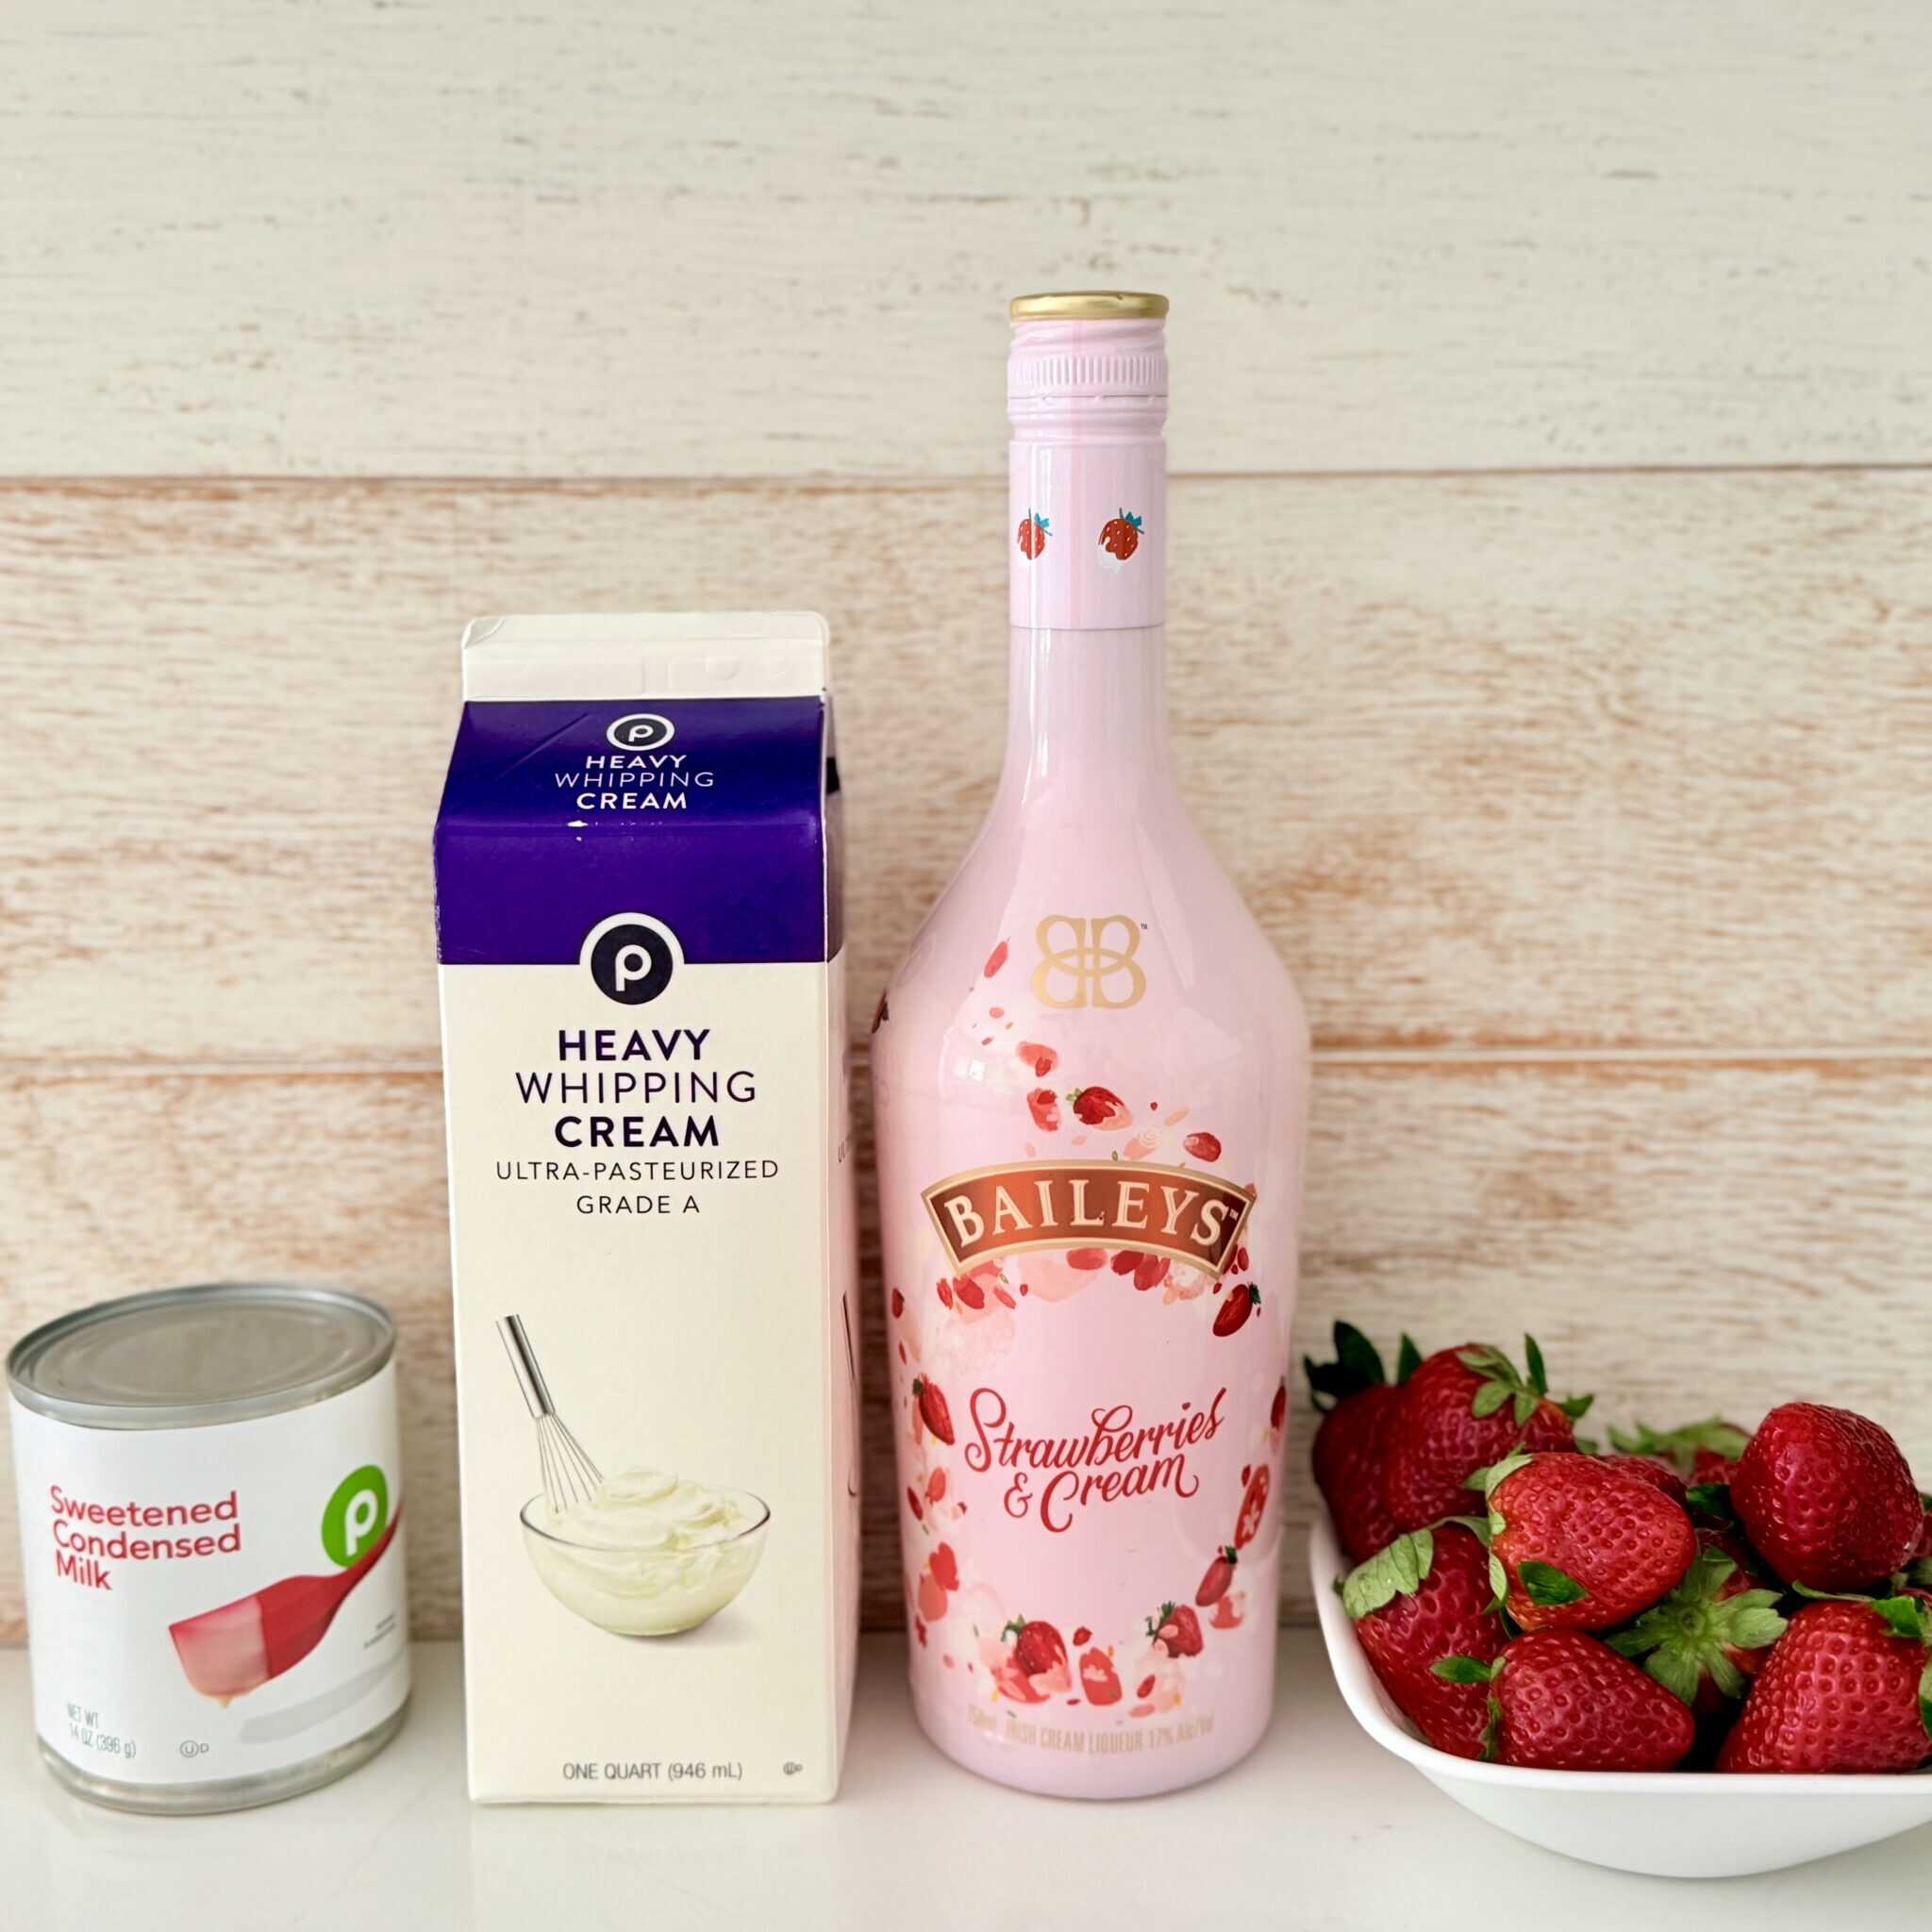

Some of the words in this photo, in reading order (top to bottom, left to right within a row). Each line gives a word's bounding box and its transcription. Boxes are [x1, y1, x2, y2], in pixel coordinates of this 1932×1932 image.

[585, 755, 688, 769] HEAVY
[555, 772, 714, 788] WHIPPING
[576, 791, 687, 809] CREAM
[558, 1028, 710, 1061] HEAVY
[515, 1071, 757, 1104] WHIPPING
[555, 1115, 720, 1148] CREAM
[495, 1159, 779, 1181] ULTRA-PASTEURIZED
[575, 1195, 672, 1214] GRADE
[682, 1195, 700, 1214] A
[944, 1178, 1230, 1249] BAILEYS
[964, 1387, 1227, 1473] Strawberries
[50, 1484, 238, 1527] Sweetened
[1003, 1472, 1034, 1519] &
[1040, 1453, 1200, 1533] Cream
[53, 1519, 242, 1560] Condensed
[56, 1548, 112, 1591] Milk
[67, 1702, 82, 1723] NET
[84, 1708, 99, 1729] WT
[81, 1727, 93, 1747] OZ
[96, 1734, 121, 1755] (396
[124, 1738, 137, 1759] g)
[1041, 1728, 1085, 1753] CREAM
[1089, 1729, 1143, 1754] LIQUEUR
[562, 1762, 599, 1780] ONE
[604, 1762, 661, 1780] QUART
[667, 1761, 707, 1781] (946
[712, 1761, 743, 1781] mL)
